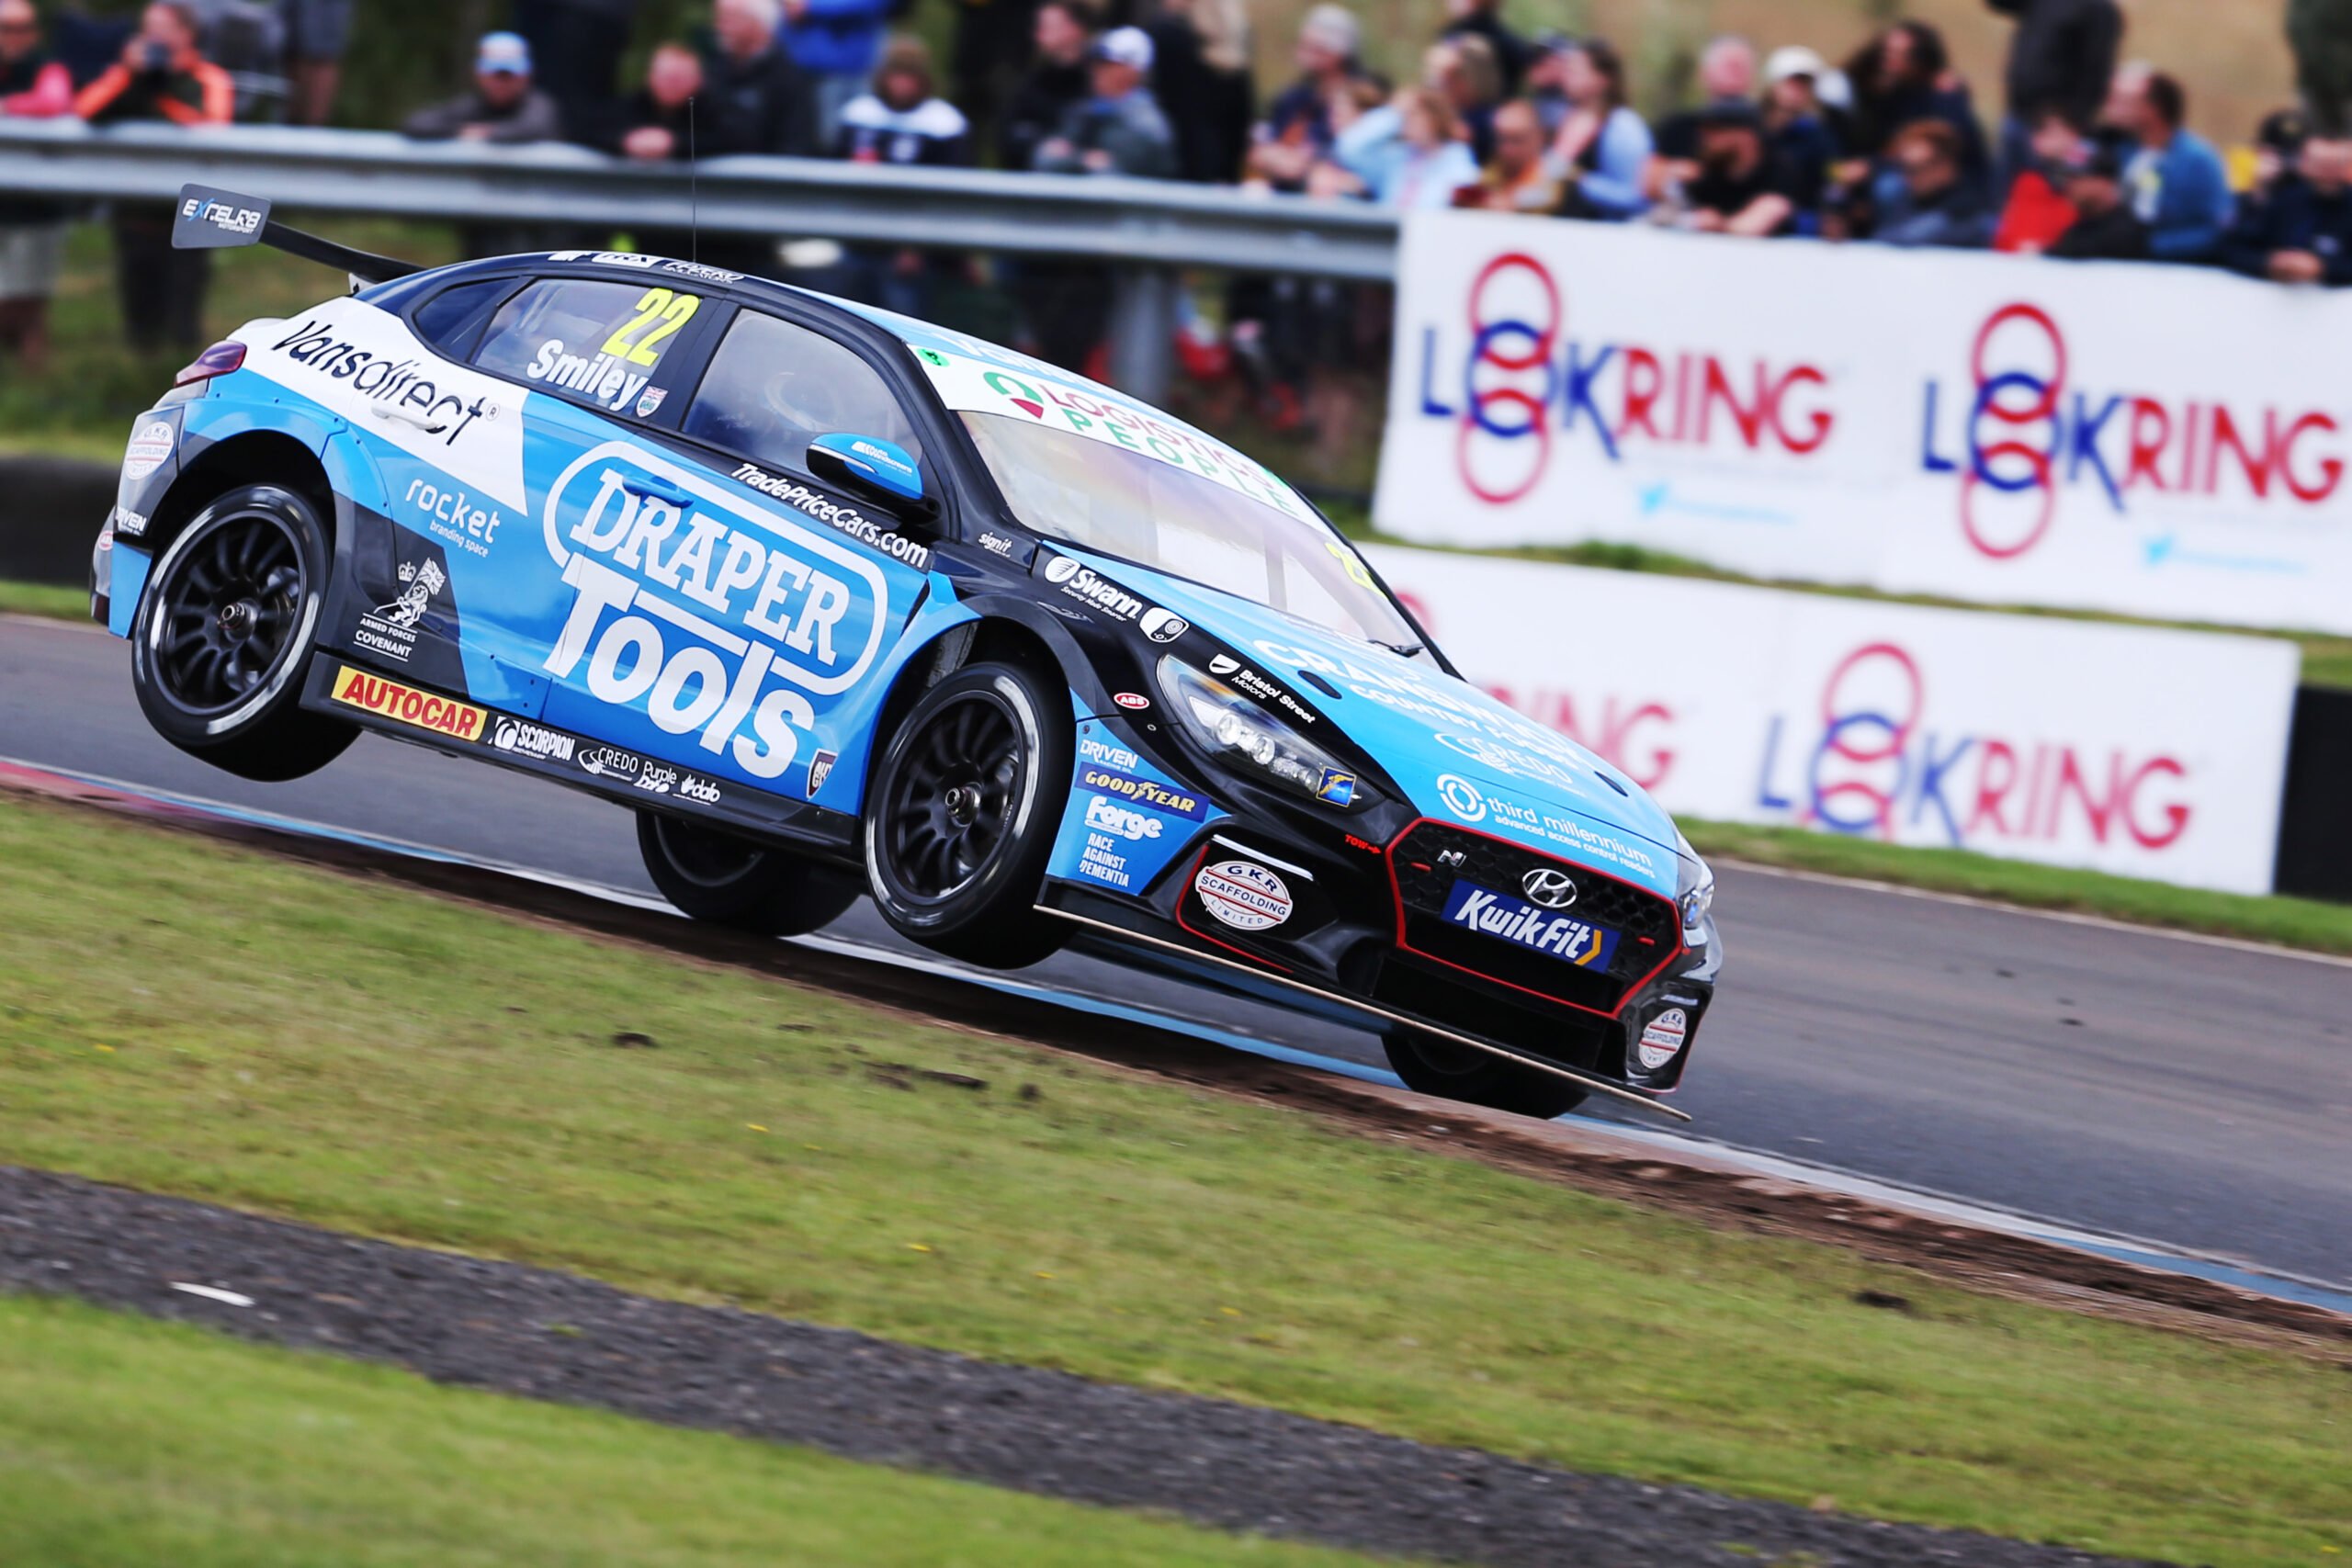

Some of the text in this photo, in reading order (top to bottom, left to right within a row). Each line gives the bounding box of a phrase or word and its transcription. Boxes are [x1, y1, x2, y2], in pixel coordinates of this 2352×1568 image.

[600, 288, 700, 367] 22
[527, 339, 649, 411] Smiley
[1038, 384, 1273, 489] LOGISTICS
[1061, 408, 1298, 516] PEOPLE
[405, 479, 500, 544] rocket
[731, 463, 929, 568] TradePriceCars.com
[429, 520, 489, 558] branding space
[978, 532, 1012, 551] signit
[570, 468, 850, 667] DRAPER
[356, 629, 412, 658] COVENANT
[360, 617, 416, 643] ARMED FORCES
[543, 551, 815, 779] Tools
[342, 674, 478, 738] AUTOCAR
[1231, 676, 1267, 699] Motors
[1239, 670, 1316, 724] Bristol Street
[518, 724, 575, 761] SCORPION
[597, 746, 639, 773] CREDO
[1080, 739, 1138, 769] DRIVEN
[643, 761, 677, 784] Purple
[1088, 832, 1114, 852] RACE
[1345, 834, 1369, 851] TOW
[1487, 797, 1652, 866] third millennium
[1495, 815, 1545, 837] advanced
[1547, 830, 1581, 849] access
[1583, 842, 1618, 862] control
[1079, 860, 1130, 887] DEMENTIA
[1082, 846, 1126, 871] AGAINST
[1201, 875, 1287, 916] SCAFFOLDING
[1227, 865, 1277, 892] GKR
[1211, 900, 1263, 924] LIMITED
